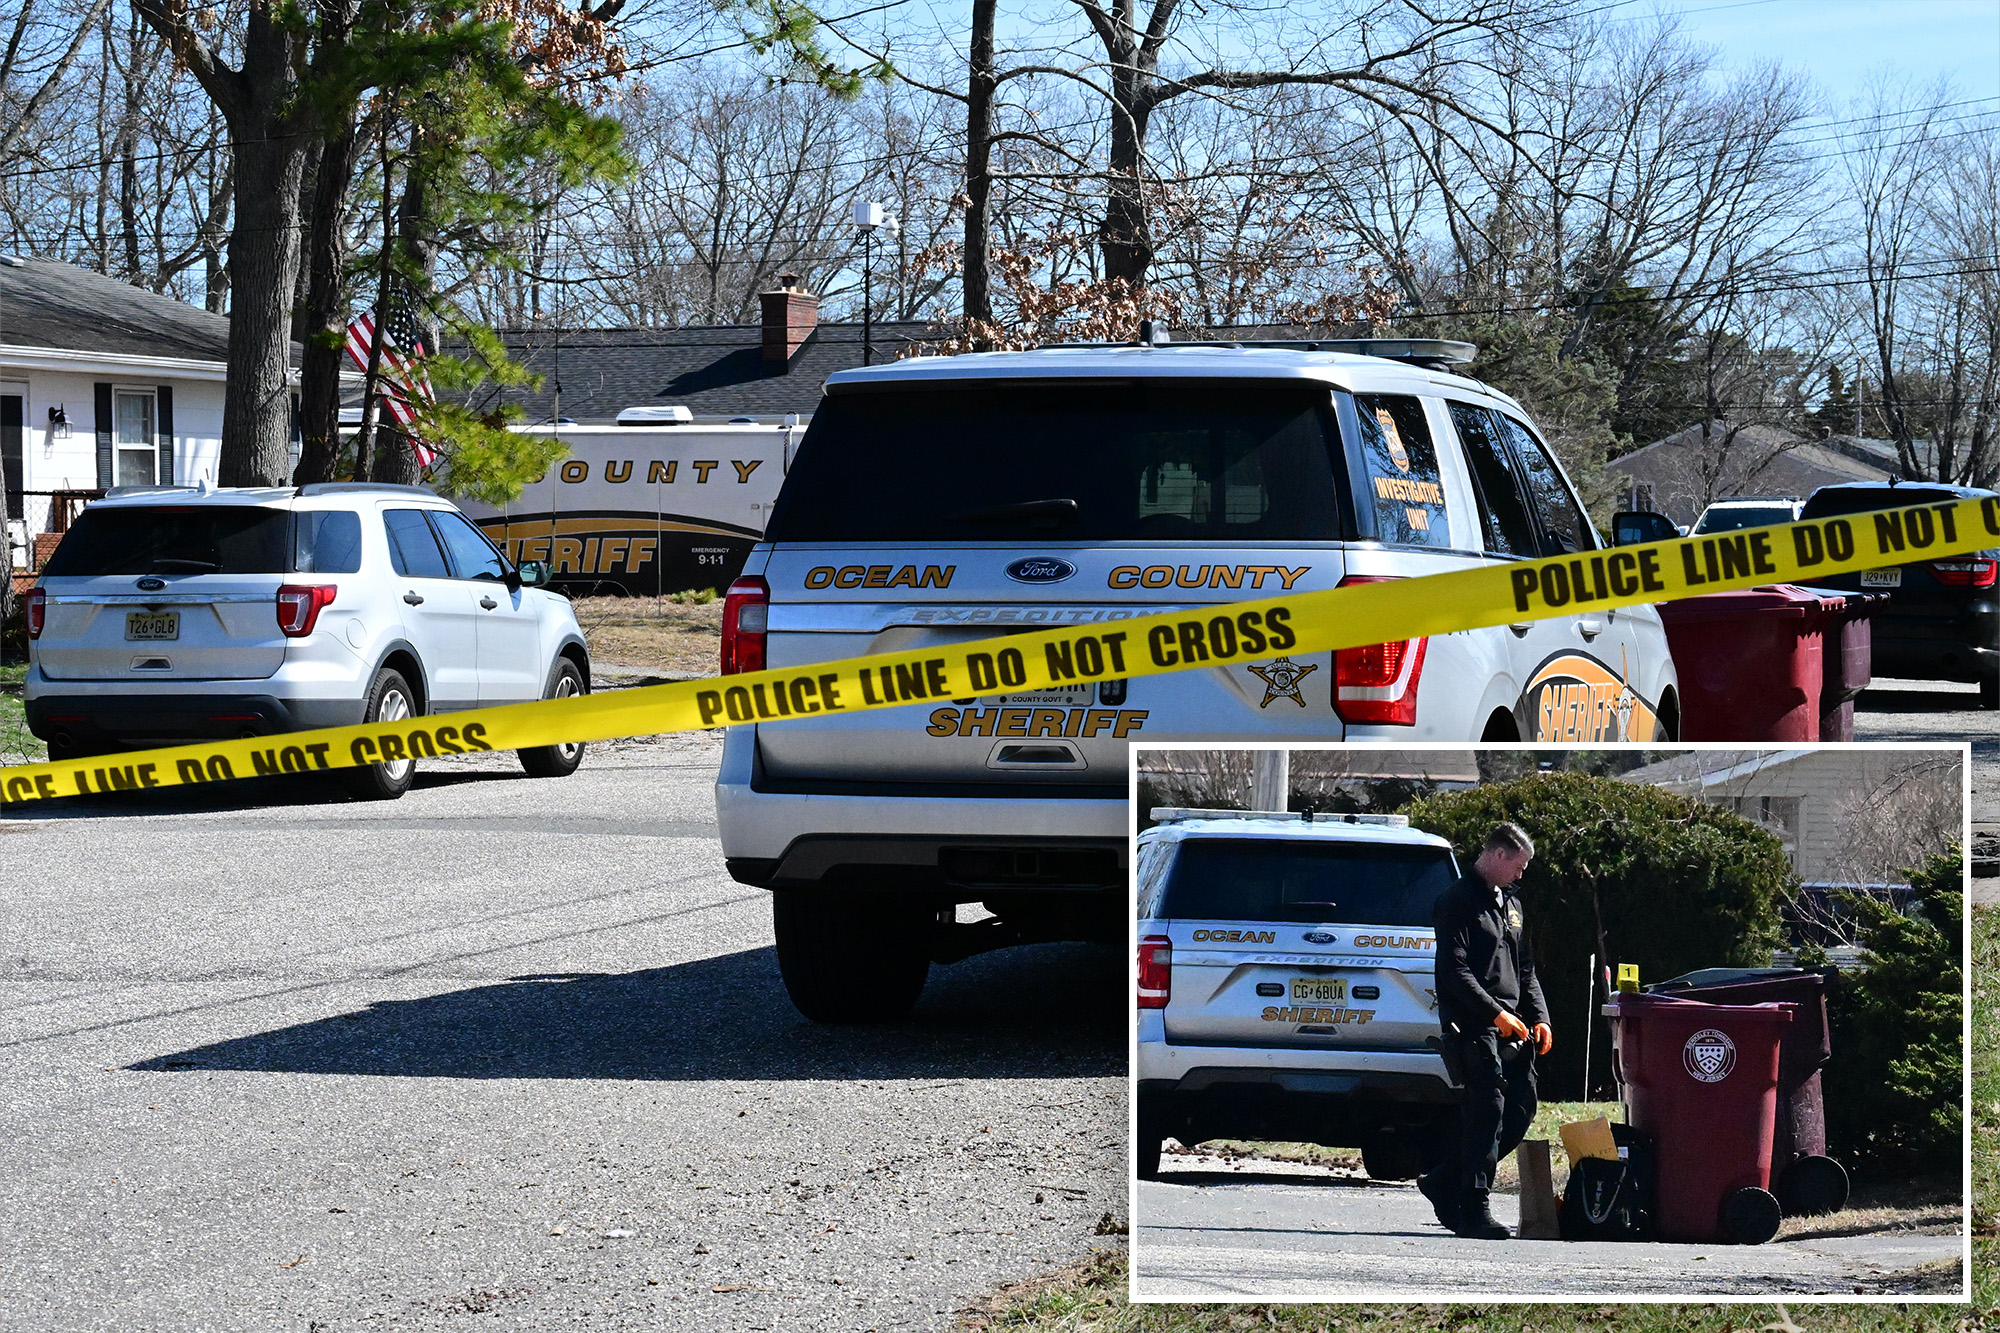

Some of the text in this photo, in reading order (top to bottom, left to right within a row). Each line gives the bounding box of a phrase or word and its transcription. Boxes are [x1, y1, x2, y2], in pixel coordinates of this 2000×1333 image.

[524, 460, 763, 484] OUNTY
[1374, 477, 1444, 505] INVESTIGATIVE
[1406, 508, 1429, 531] UNIT
[1511, 548, 1664, 612] POLICE
[1683, 532, 1776, 586] LINE
[1792, 519, 1855, 568] DO
[1874, 502, 1958, 554] NOT
[804, 564, 956, 589] OCEAN
[1018, 560, 1059, 579] Ford
[1107, 564, 1311, 590] COUNTY
[697, 607, 1296, 725] POLICE LINE DO NOT CROSS
[926, 707, 1149, 738] SHERIFF
[1536, 682, 1614, 742] SHERIFF
[74, 763, 159, 794] LINE
[176, 754, 236, 784] DO
[251, 742, 330, 775] NOT
[350, 722, 493, 765] CROSS
[1192, 929, 1276, 943] OCEAN
[1309, 932, 1332, 943] Ford
[1255, 955, 1384, 966] EXPEDITION
[1624, 967, 1631, 978] 1
[1261, 1006, 1376, 1024] SHERIFF
